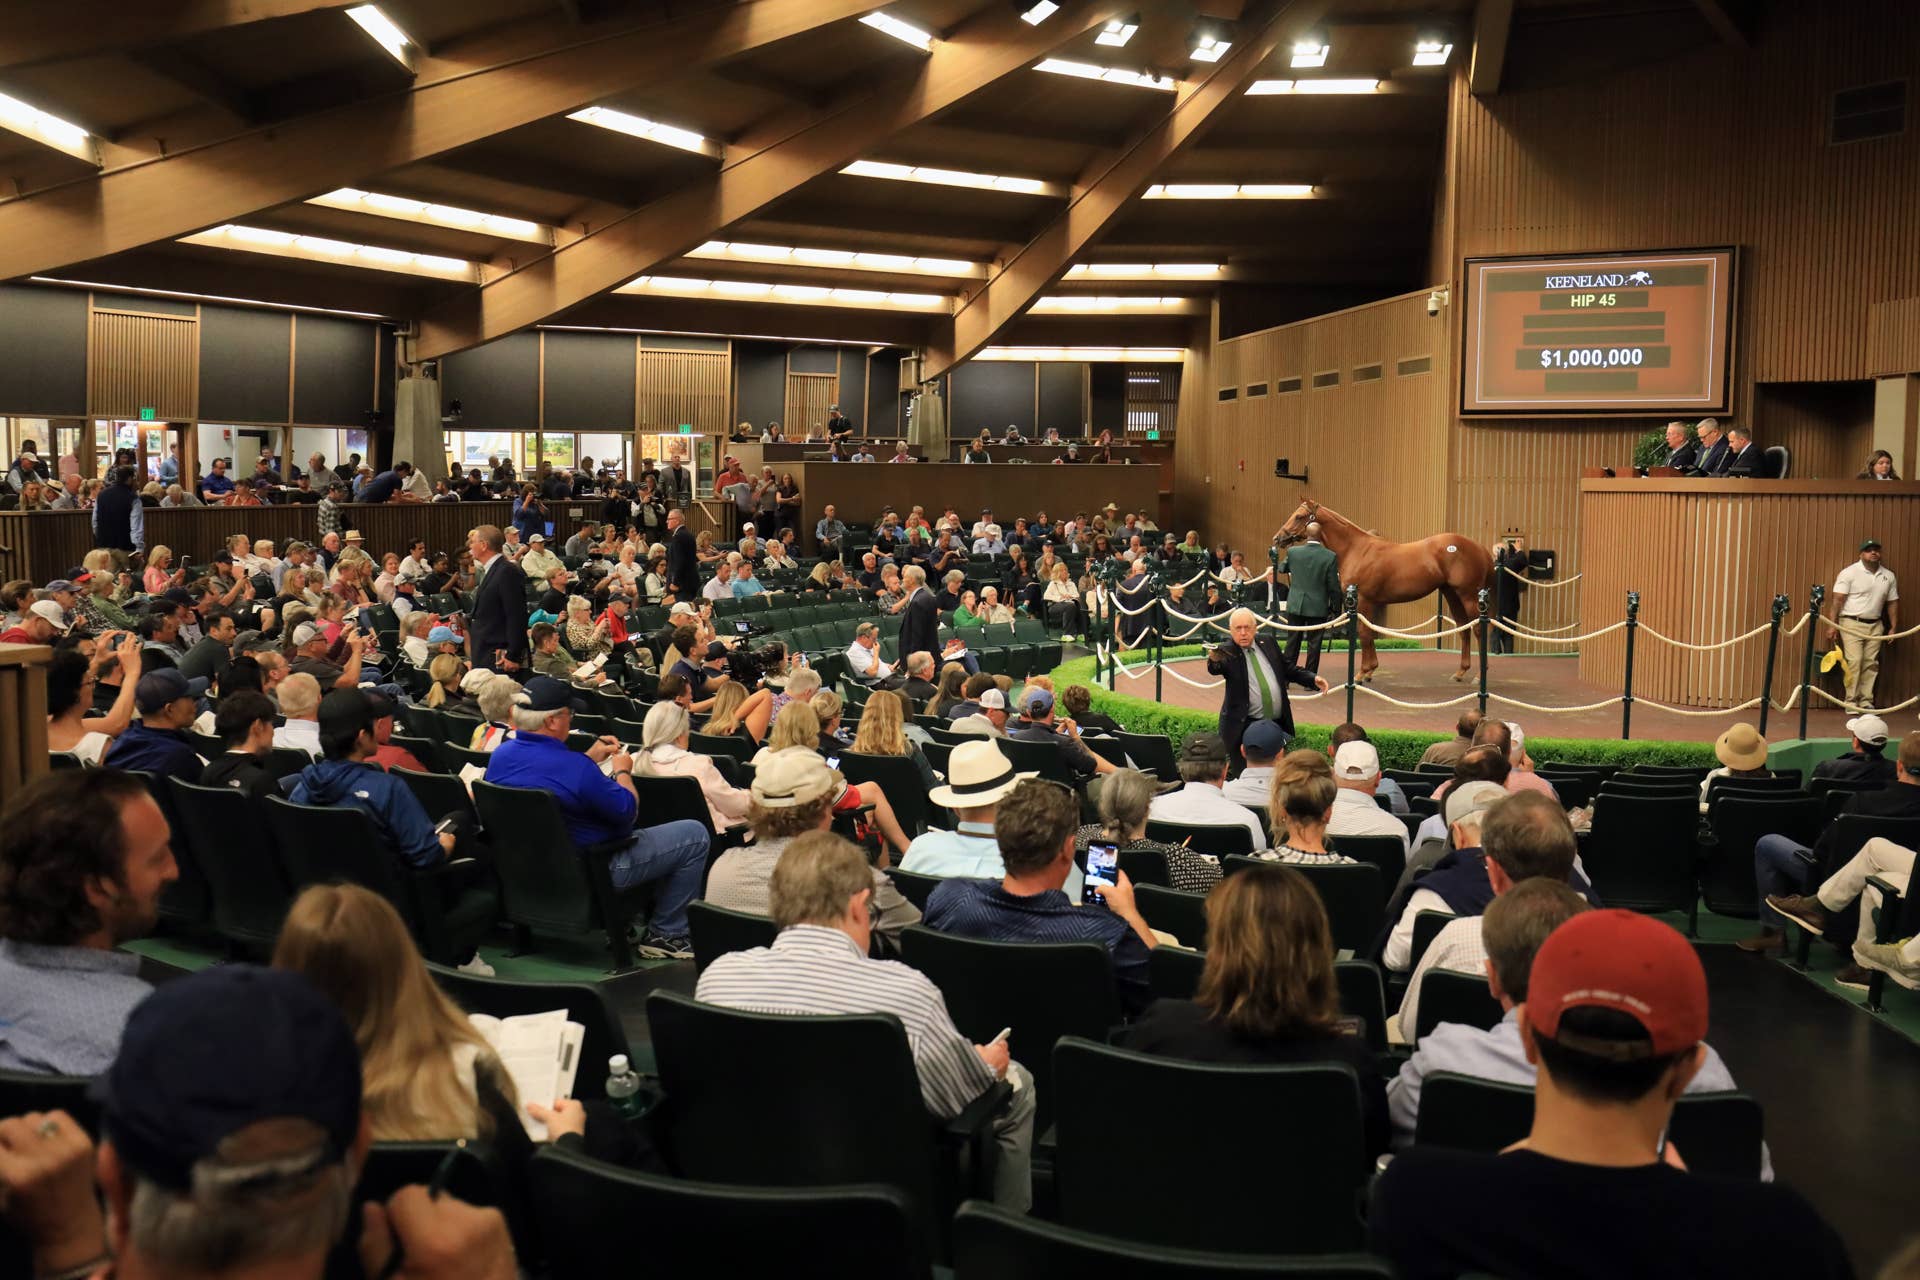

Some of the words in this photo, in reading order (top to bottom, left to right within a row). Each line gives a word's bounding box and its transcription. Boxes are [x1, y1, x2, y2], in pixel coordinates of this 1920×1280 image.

[1545, 274, 1624, 288] KEENELAND
[1571, 294, 1595, 307] HIP
[1599, 293, 1616, 306] 45
[1541, 348, 1642, 368] $1,000,000
